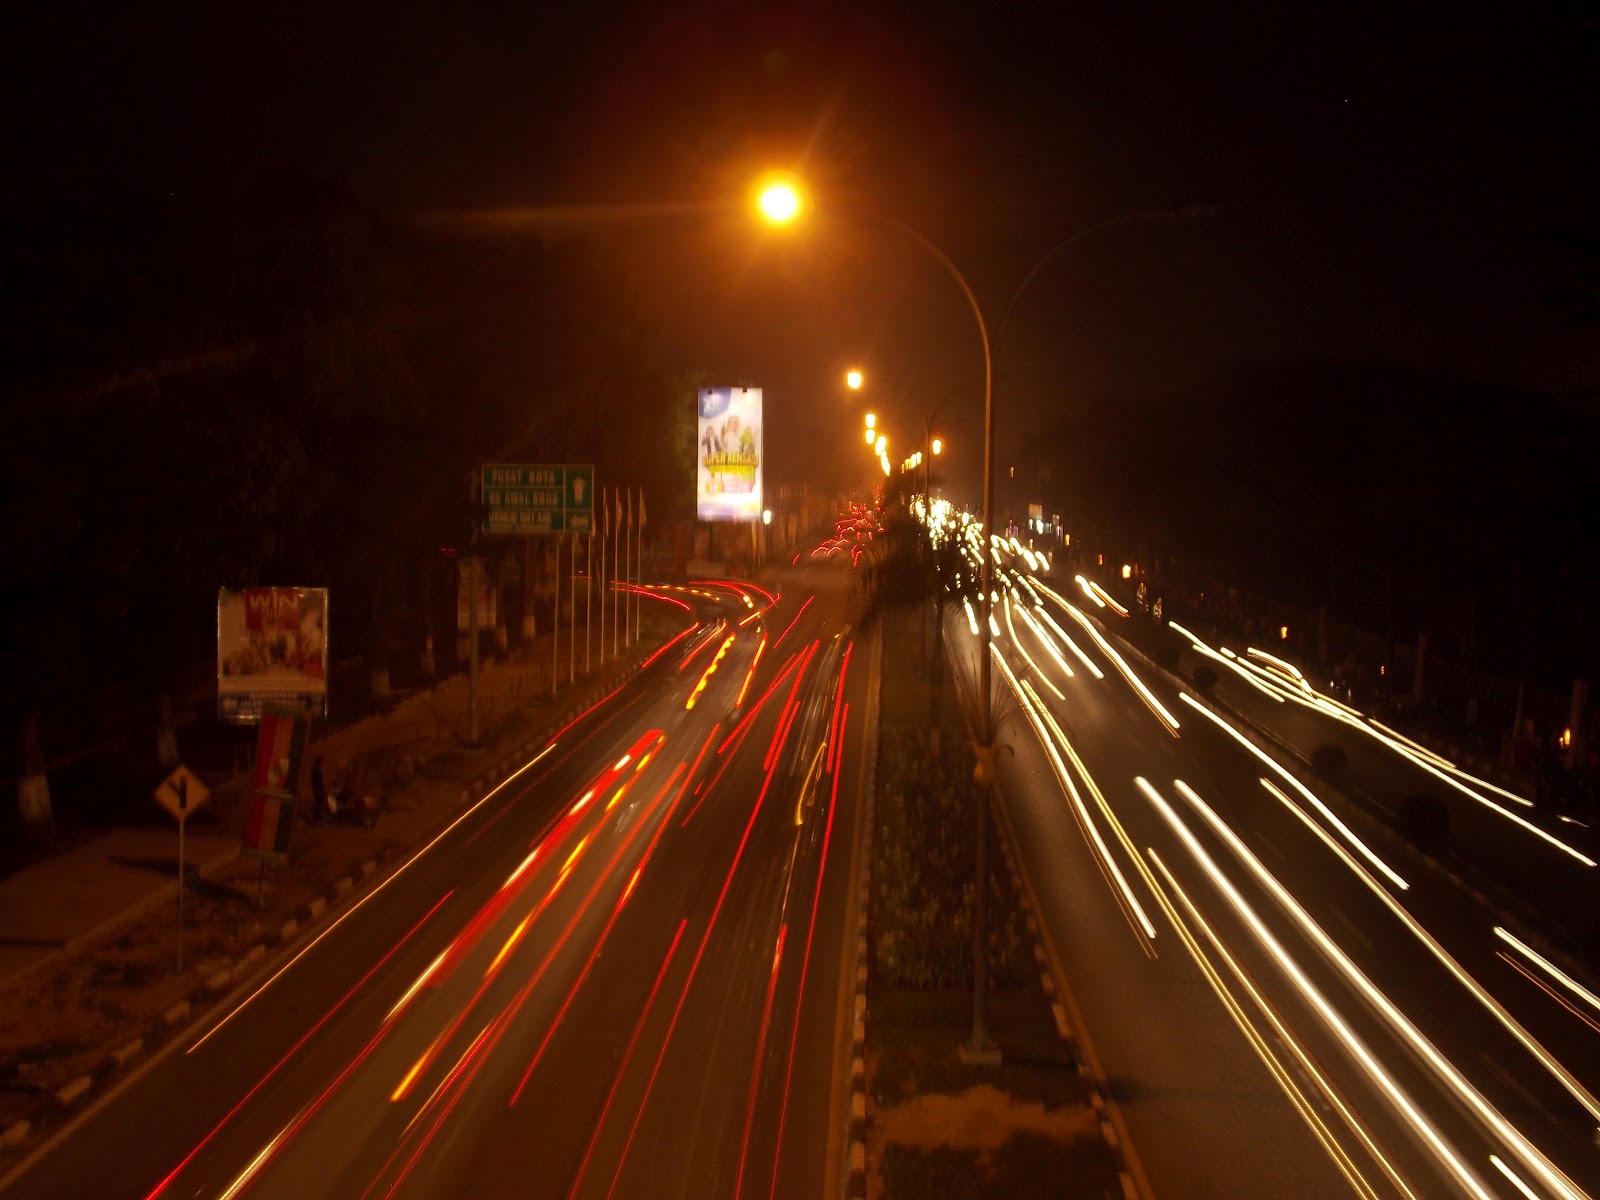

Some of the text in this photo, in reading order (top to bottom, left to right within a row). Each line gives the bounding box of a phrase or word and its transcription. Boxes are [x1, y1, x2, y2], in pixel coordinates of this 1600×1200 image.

[492, 469, 555, 483] PUSAT KOTA
[504, 491, 530, 505] AWAL
[533, 491, 558, 505] BROS
[249, 591, 298, 608] WIN
